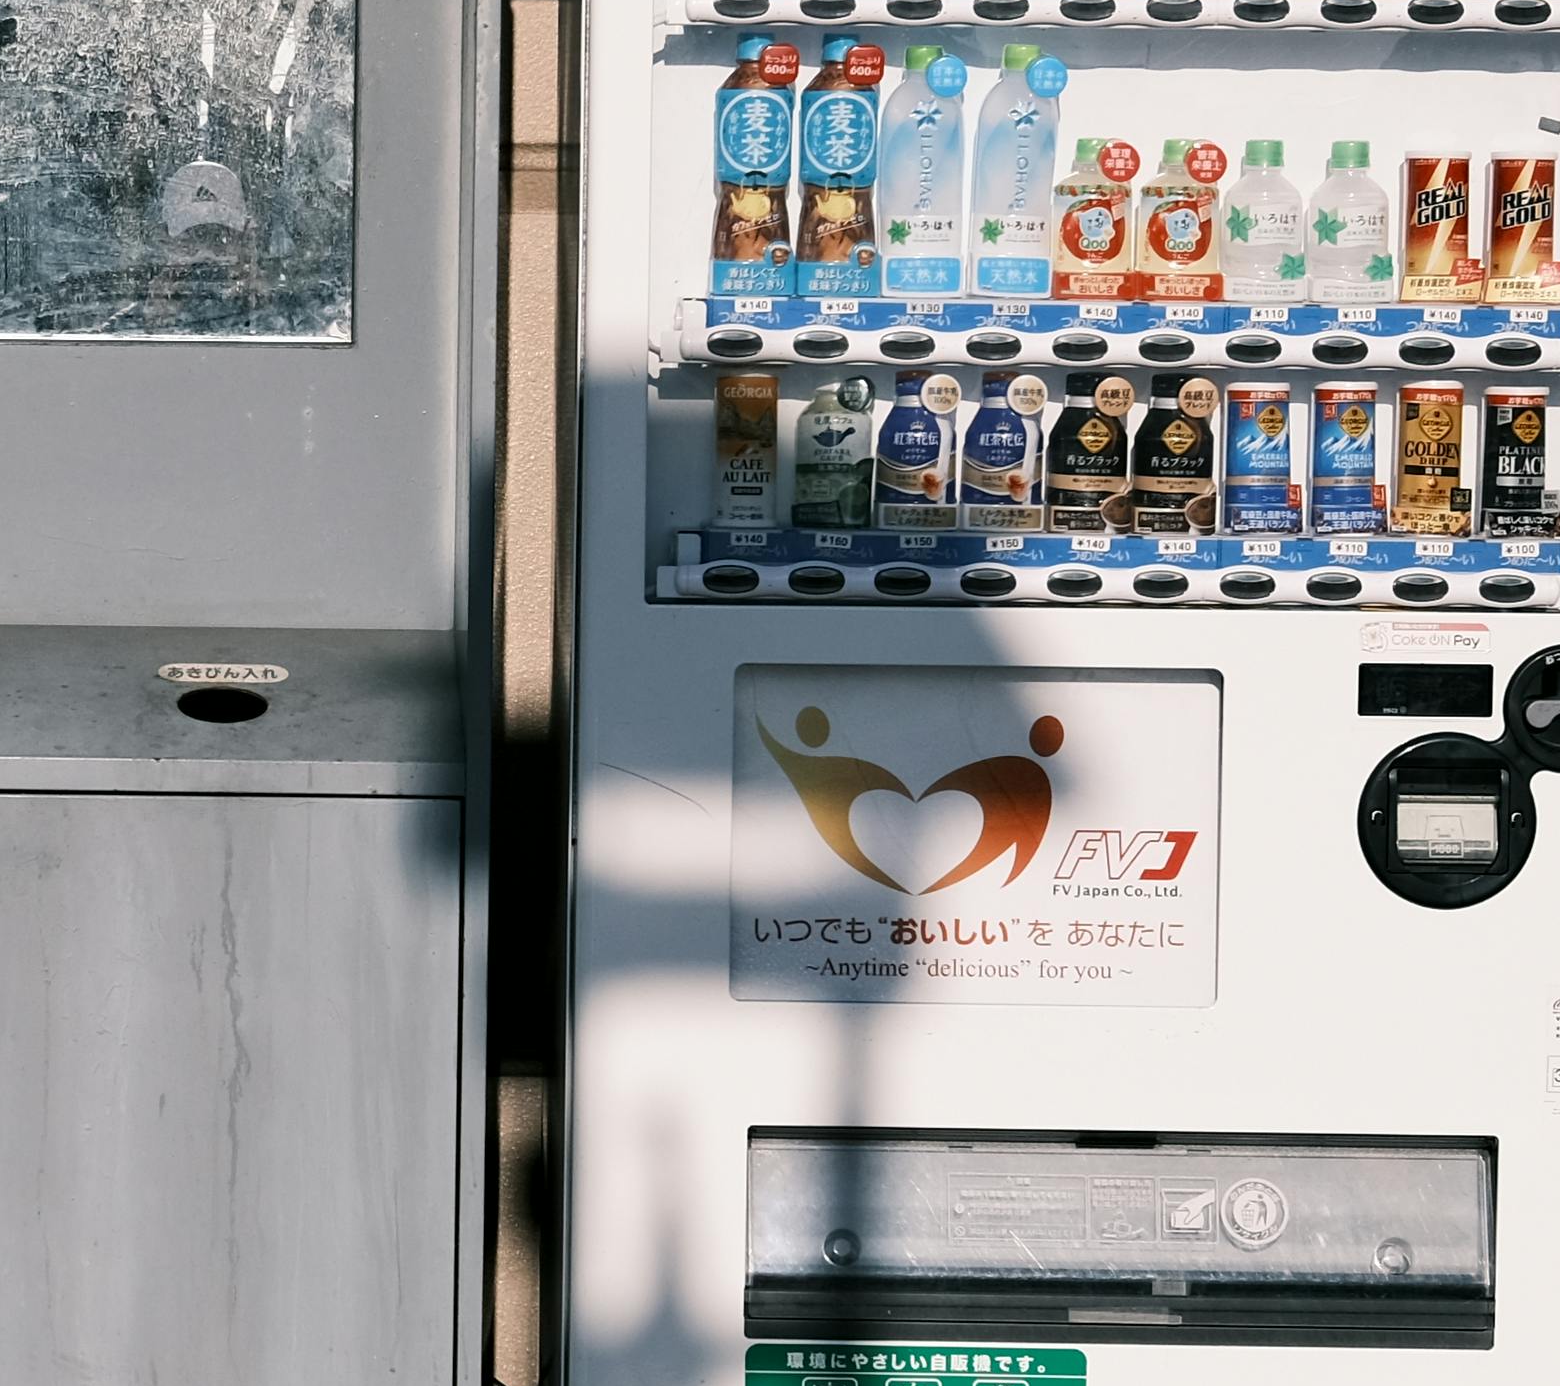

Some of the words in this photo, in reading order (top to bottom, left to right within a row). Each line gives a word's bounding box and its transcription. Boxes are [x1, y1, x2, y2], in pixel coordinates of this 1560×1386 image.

[741, 99, 772, 165] 麦茶
[1417, 178, 1466, 208] REAL
[1503, 180, 1551, 210] REAL
[1417, 201, 1467, 227] GOLD
[1502, 202, 1552, 229] GOLD
[1081, 238, 1108, 250] Qoo
[1167, 239, 1194, 251] Qoo
[900, 269, 949, 284] 天然水
[990, 269, 1039, 284] 天然水
[1255, 308, 1284, 319] ¥110
[724, 383, 773, 399] GEORGIA
[1100, 388, 1131, 400] 高級豆
[893, 431, 940, 446] 紅茶花伝
[979, 432, 1025, 447] 紅茶花伝
[730, 458, 764, 470] CAFE
[1066, 455, 1121, 466] 香るブラック
[1151, 456, 1204, 468] 香るブラック
[1419, 457, 1449, 466] DRIP
[722, 471, 742, 483] AU
[743, 471, 771, 483] LAIT
[1506, 543, 1536, 554] ¥100
[1391, 634, 1426, 646] Coke
[1453, 635, 1480, 649] Pay
[166, 665, 279, 681] あきびん入れ
[1053, 885, 1071, 898] FV
[1074, 885, 1120, 899] Japan
[1123, 885, 1151, 899] Co.,
[1155, 884, 1183, 898] Ltd.
[1067, 918, 1185, 948] あなたに
[1039, 959, 1069, 979] for
[1073, 965, 1113, 982] you
[786, 1352, 1047, 1374] 環境にやさしい自販機です。
